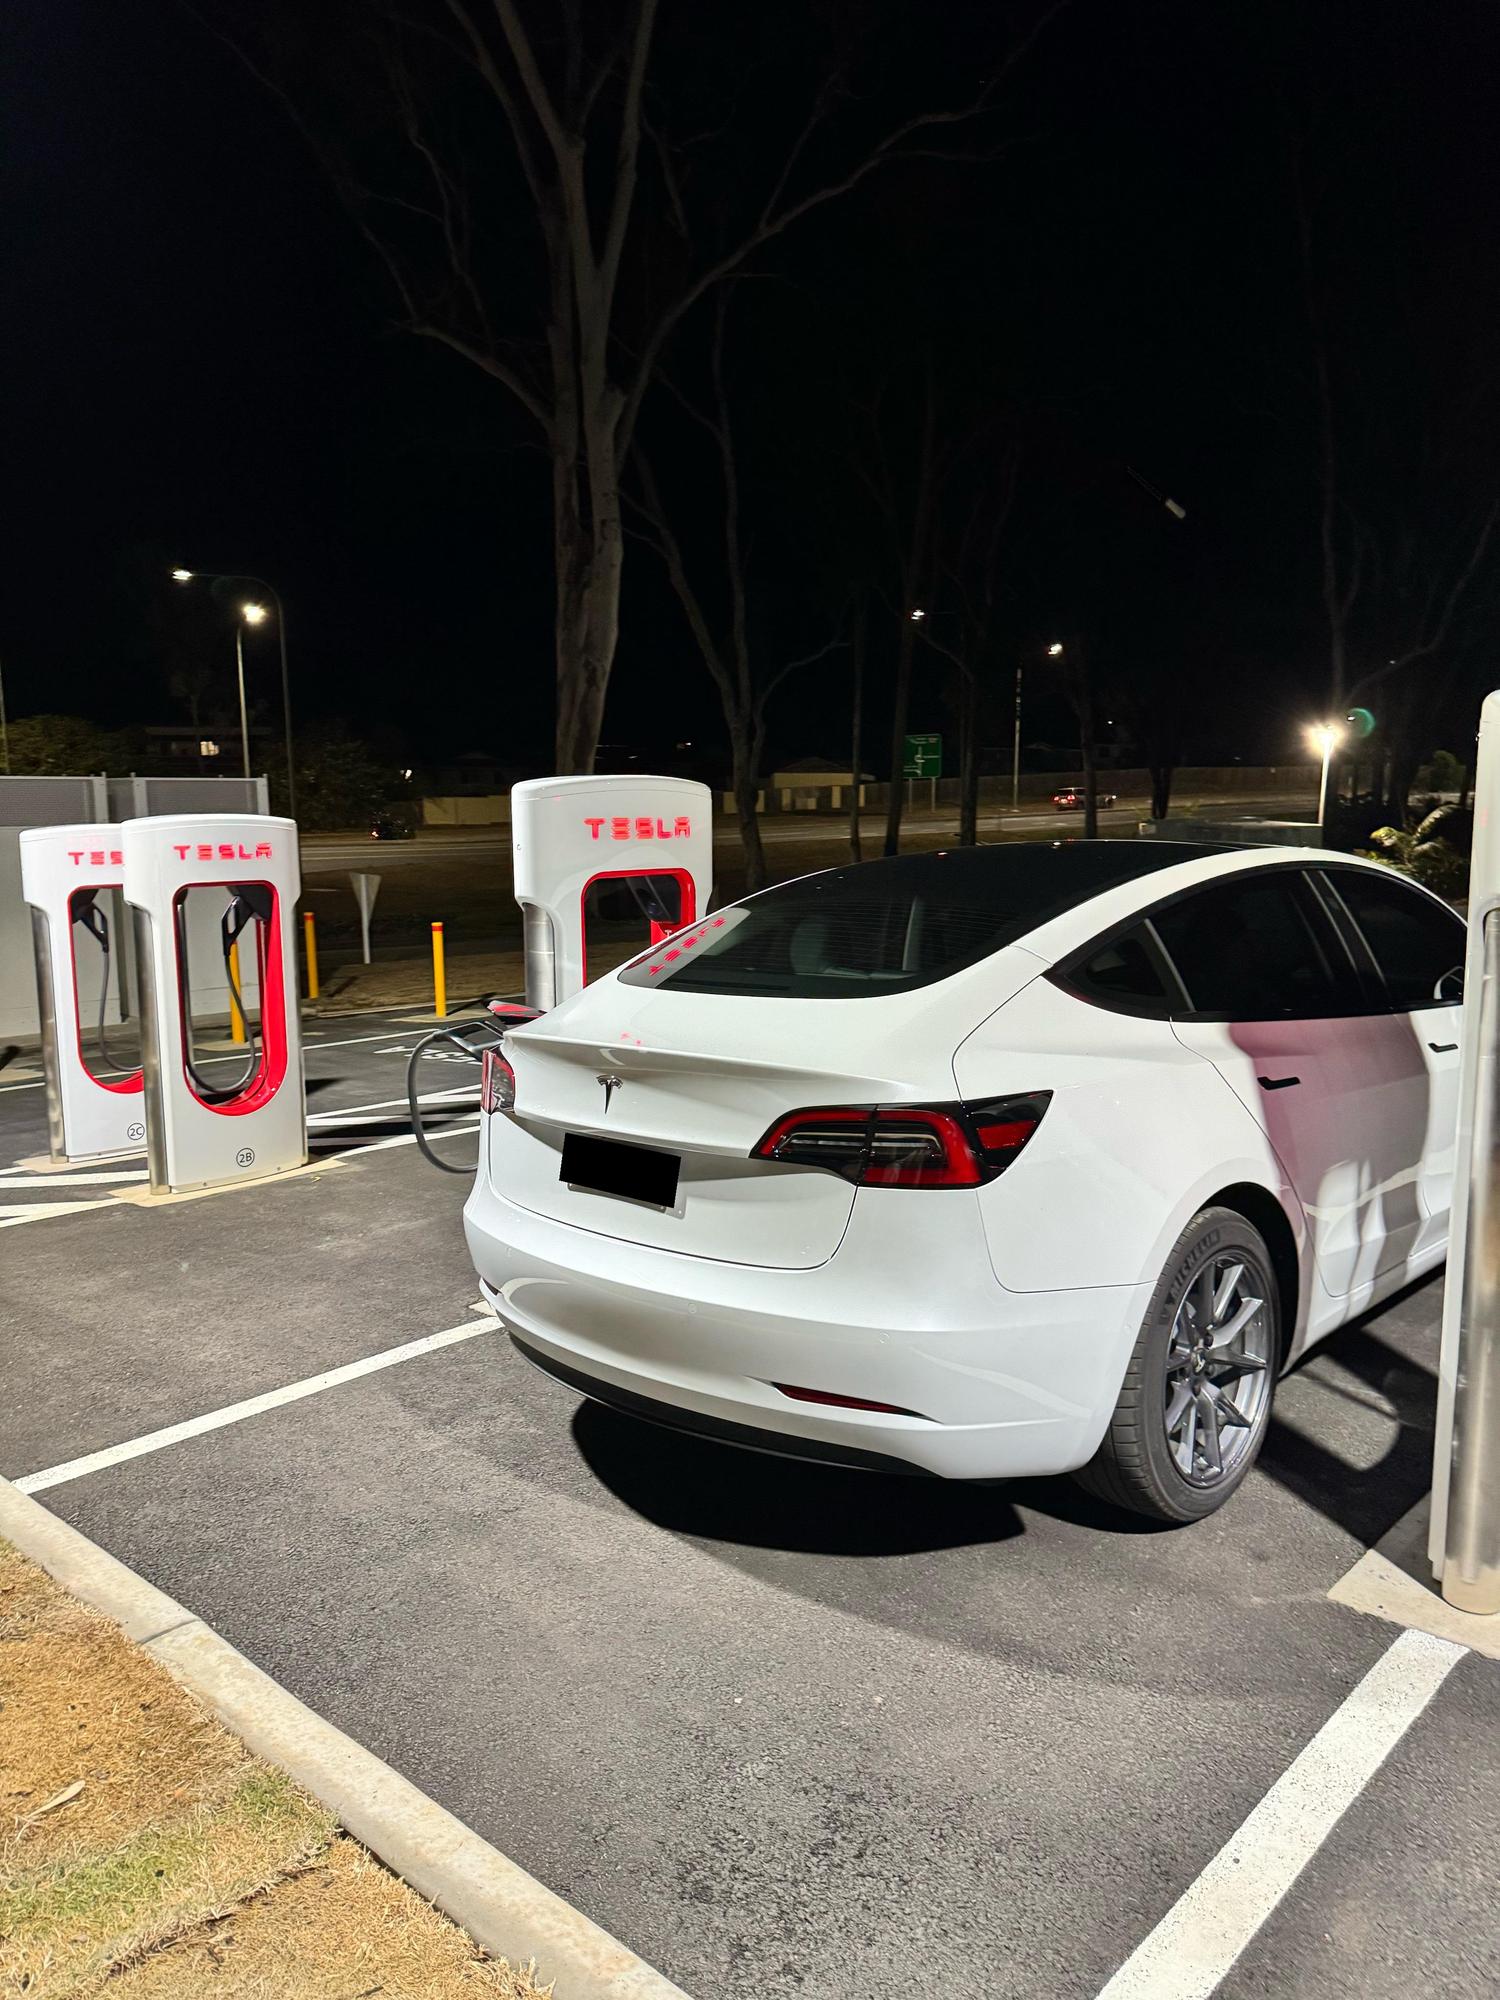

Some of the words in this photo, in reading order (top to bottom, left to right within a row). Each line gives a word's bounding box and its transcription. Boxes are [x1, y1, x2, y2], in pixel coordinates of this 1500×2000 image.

[583, 816, 691, 840] TESLA
[68, 851, 123, 865] TES
[173, 843, 273, 860] TESLA
[130, 1126, 143, 1136] 2C
[239, 1152, 252, 1163] 2B
